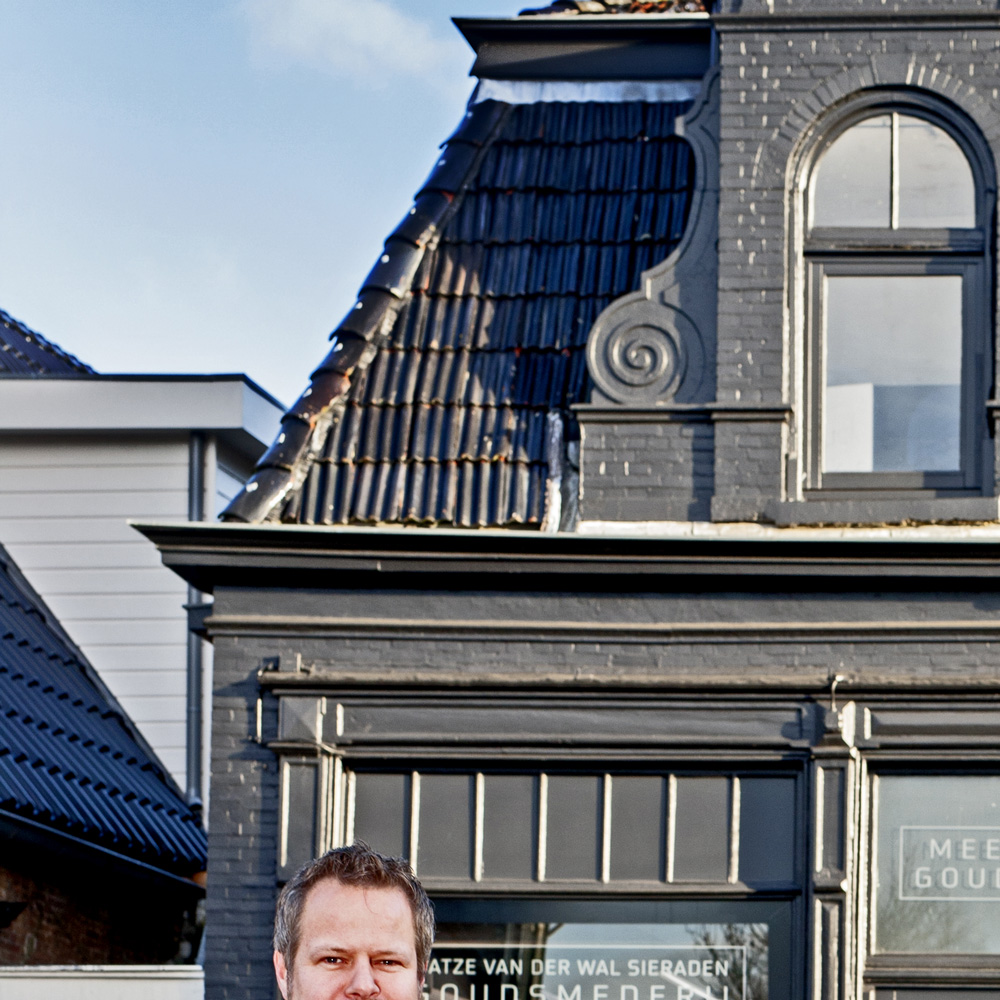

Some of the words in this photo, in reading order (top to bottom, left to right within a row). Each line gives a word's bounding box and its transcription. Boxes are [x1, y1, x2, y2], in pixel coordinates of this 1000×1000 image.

[427, 957, 477, 976] ATZE
[482, 958, 523, 976] VAN
[530, 958, 571, 976] DER
[576, 959, 621, 977] WAL
[627, 959, 729, 978] SIERADEN
